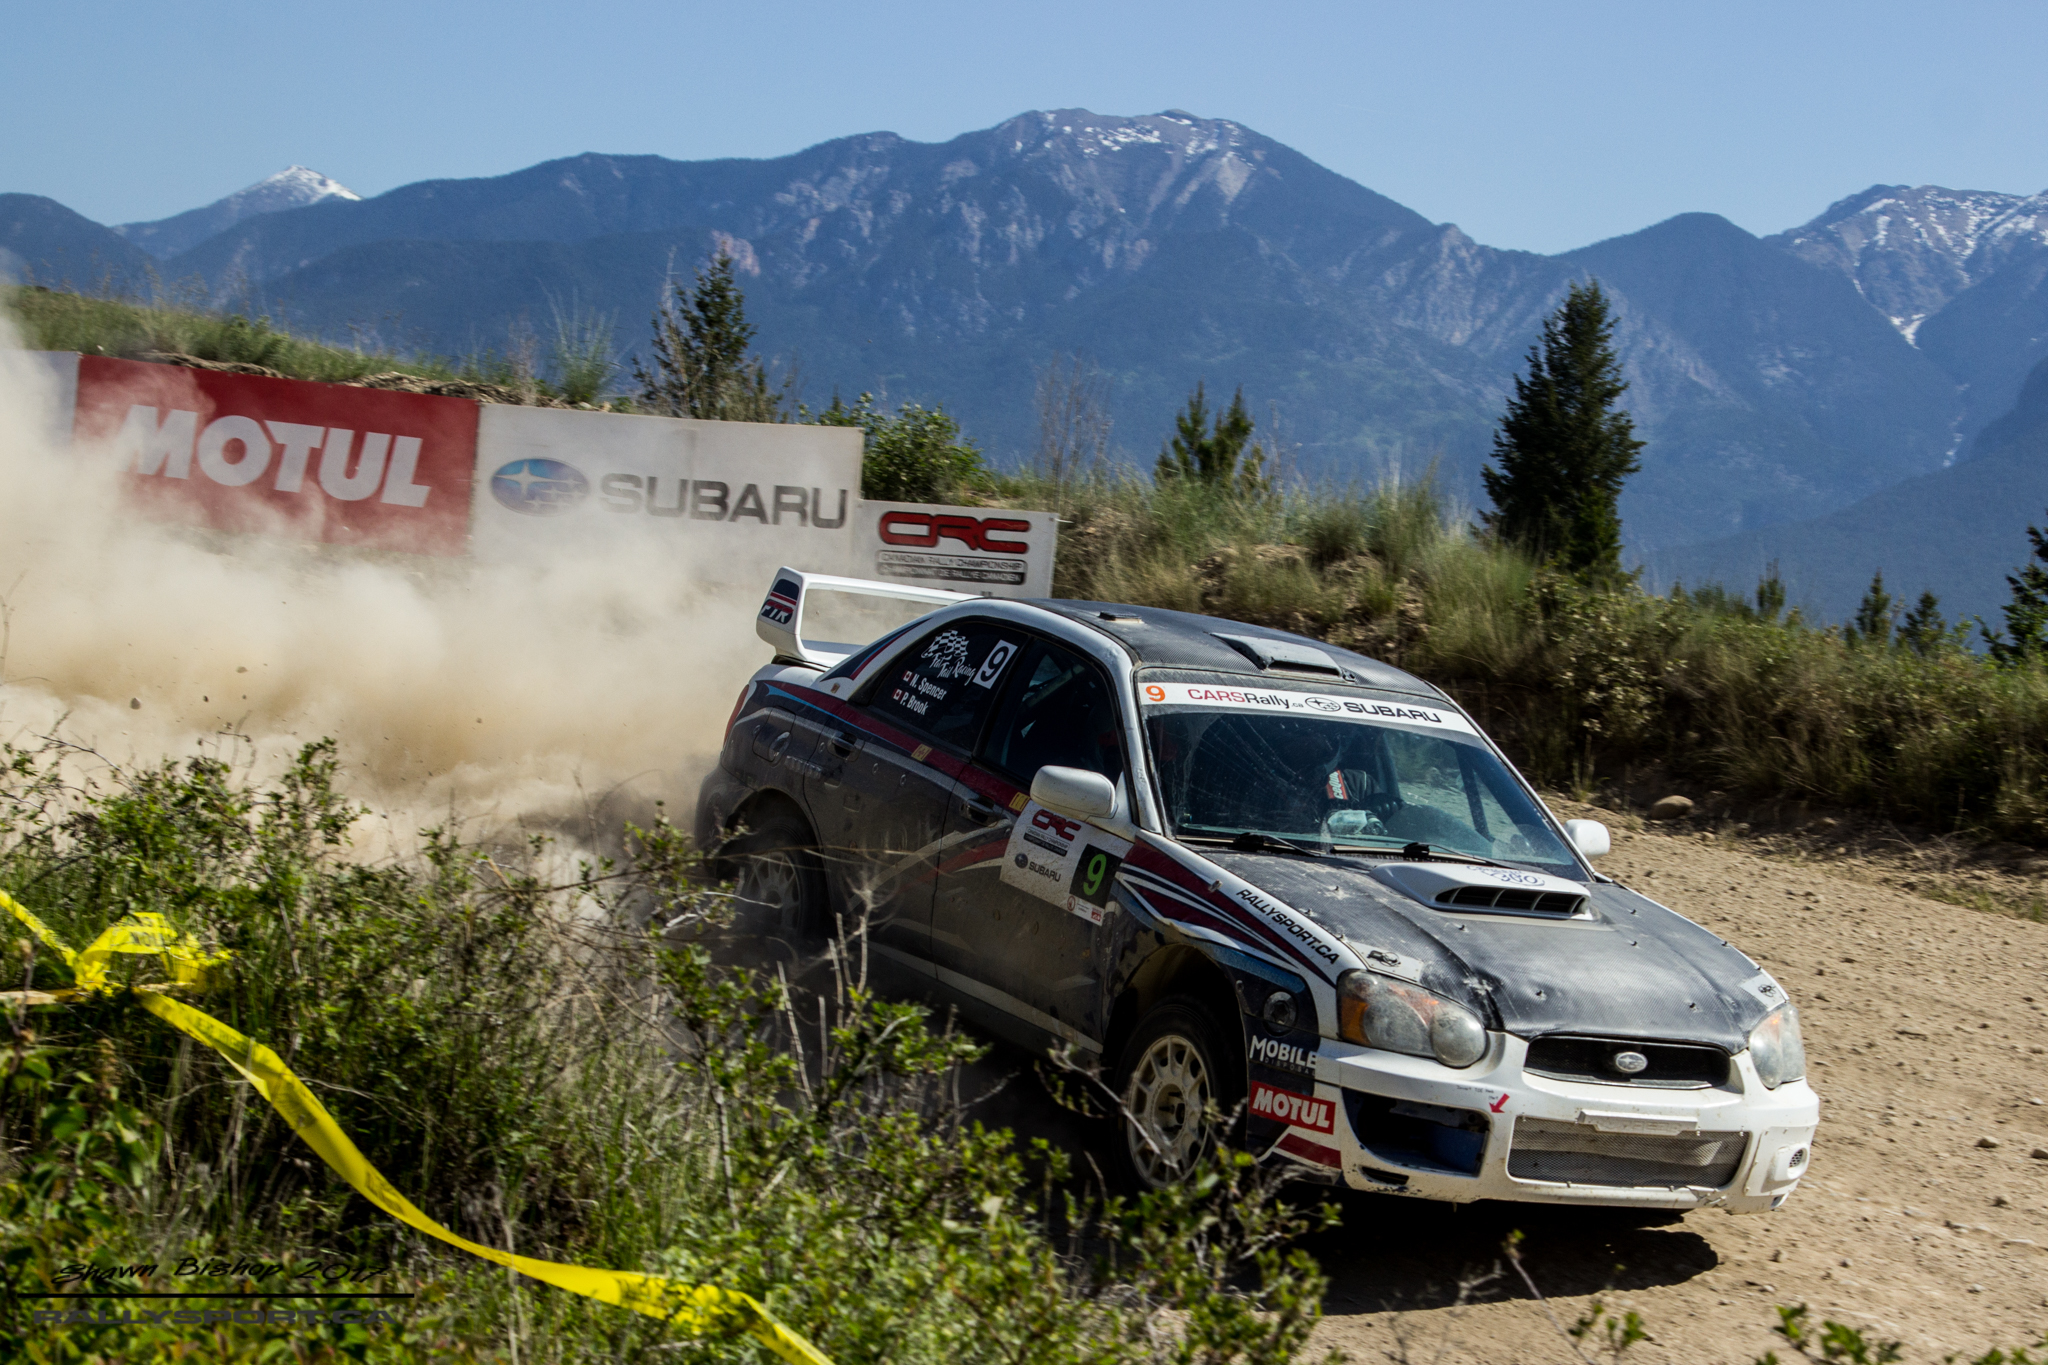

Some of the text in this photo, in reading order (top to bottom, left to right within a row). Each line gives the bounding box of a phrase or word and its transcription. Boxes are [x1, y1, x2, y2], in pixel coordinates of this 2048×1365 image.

[118, 404, 431, 508] MOTUL
[600, 472, 849, 530] SUBARU
[879, 511, 1030, 554] CRC
[980, 645, 1010, 683] 9
[906, 694, 929, 716] Brook
[918, 677, 948, 701] Spencer
[1145, 685, 1166, 702] 9
[1343, 701, 1442, 723] SUBARU
[1031, 808, 1082, 842] CRC
[1028, 861, 1062, 882] SUBARU
[1083, 853, 1107, 896] 9
[1235, 888, 1340, 965] RALLYSPORT.CA
[1249, 1034, 1318, 1070] MOBILE
[1252, 1087, 1331, 1129] MOTUL
